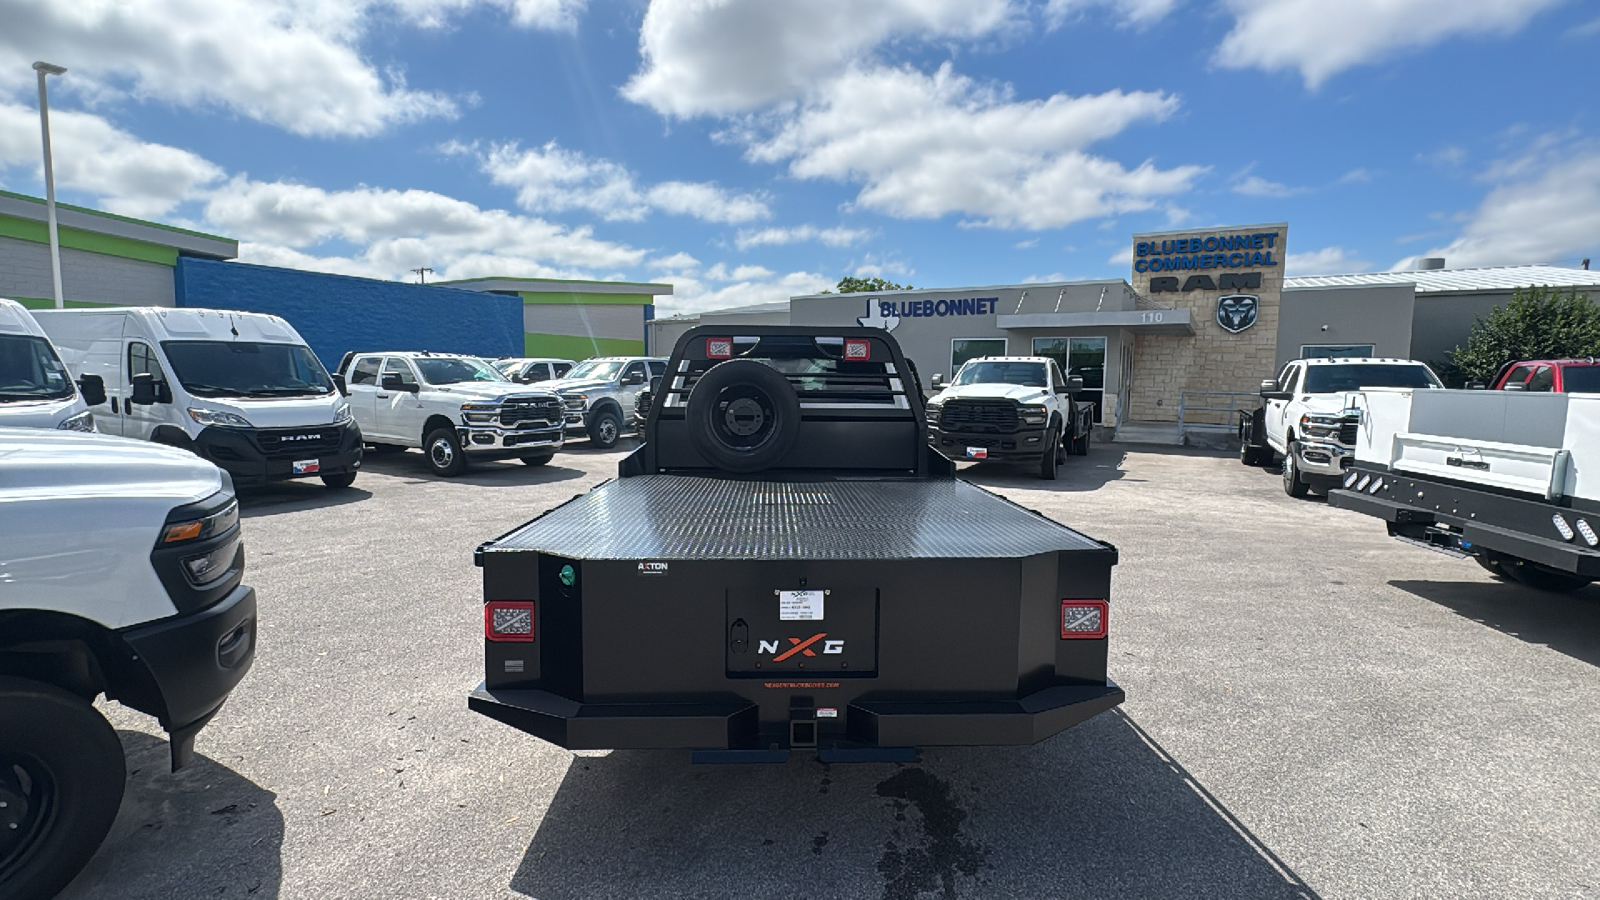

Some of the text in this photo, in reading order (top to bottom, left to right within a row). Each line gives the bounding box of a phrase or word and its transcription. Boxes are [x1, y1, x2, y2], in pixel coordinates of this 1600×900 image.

[1136, 232, 1279, 257] BLUEBONNET
[1134, 251, 1278, 273] COMMERCIAL
[1150, 272, 1262, 293] RAM
[880, 297, 999, 317] BLUEBONNET
[1140, 312, 1163, 323] 110
[637, 562, 668, 570] AXTON
